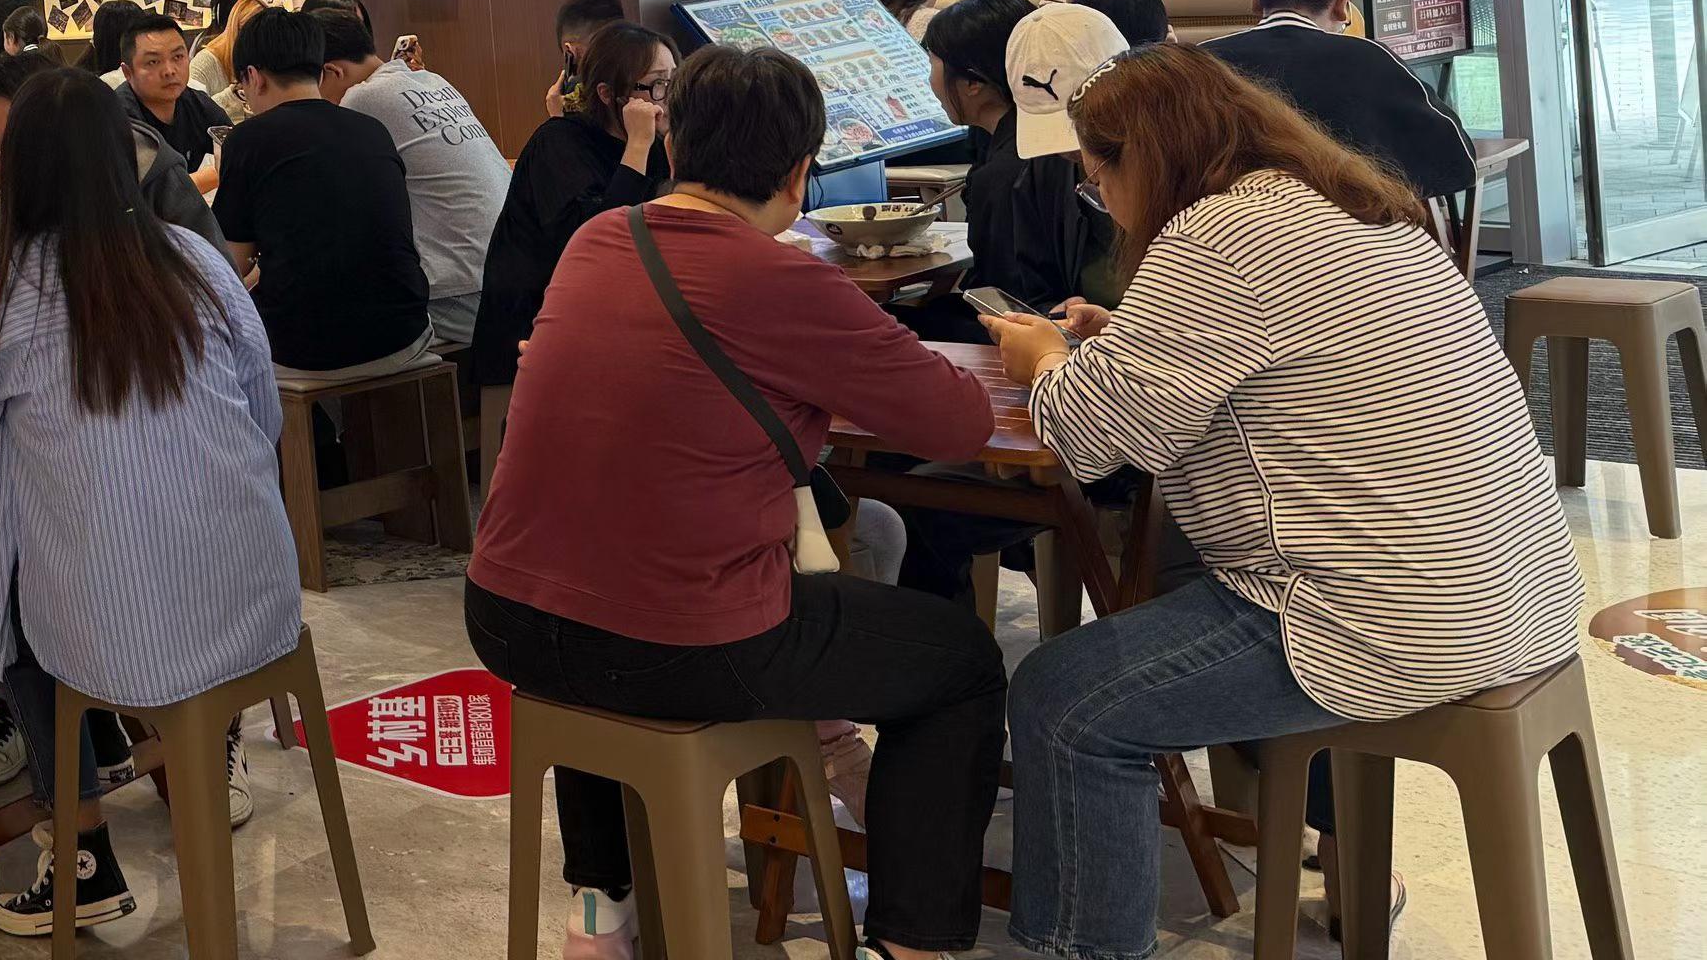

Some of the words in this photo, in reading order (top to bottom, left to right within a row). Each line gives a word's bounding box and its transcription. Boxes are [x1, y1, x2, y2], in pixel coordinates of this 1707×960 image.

[366, 696, 428, 766] 乡村基
[438, 730, 463, 764] 一日三餐
[467, 694, 497, 766] 集团直营超1800家
